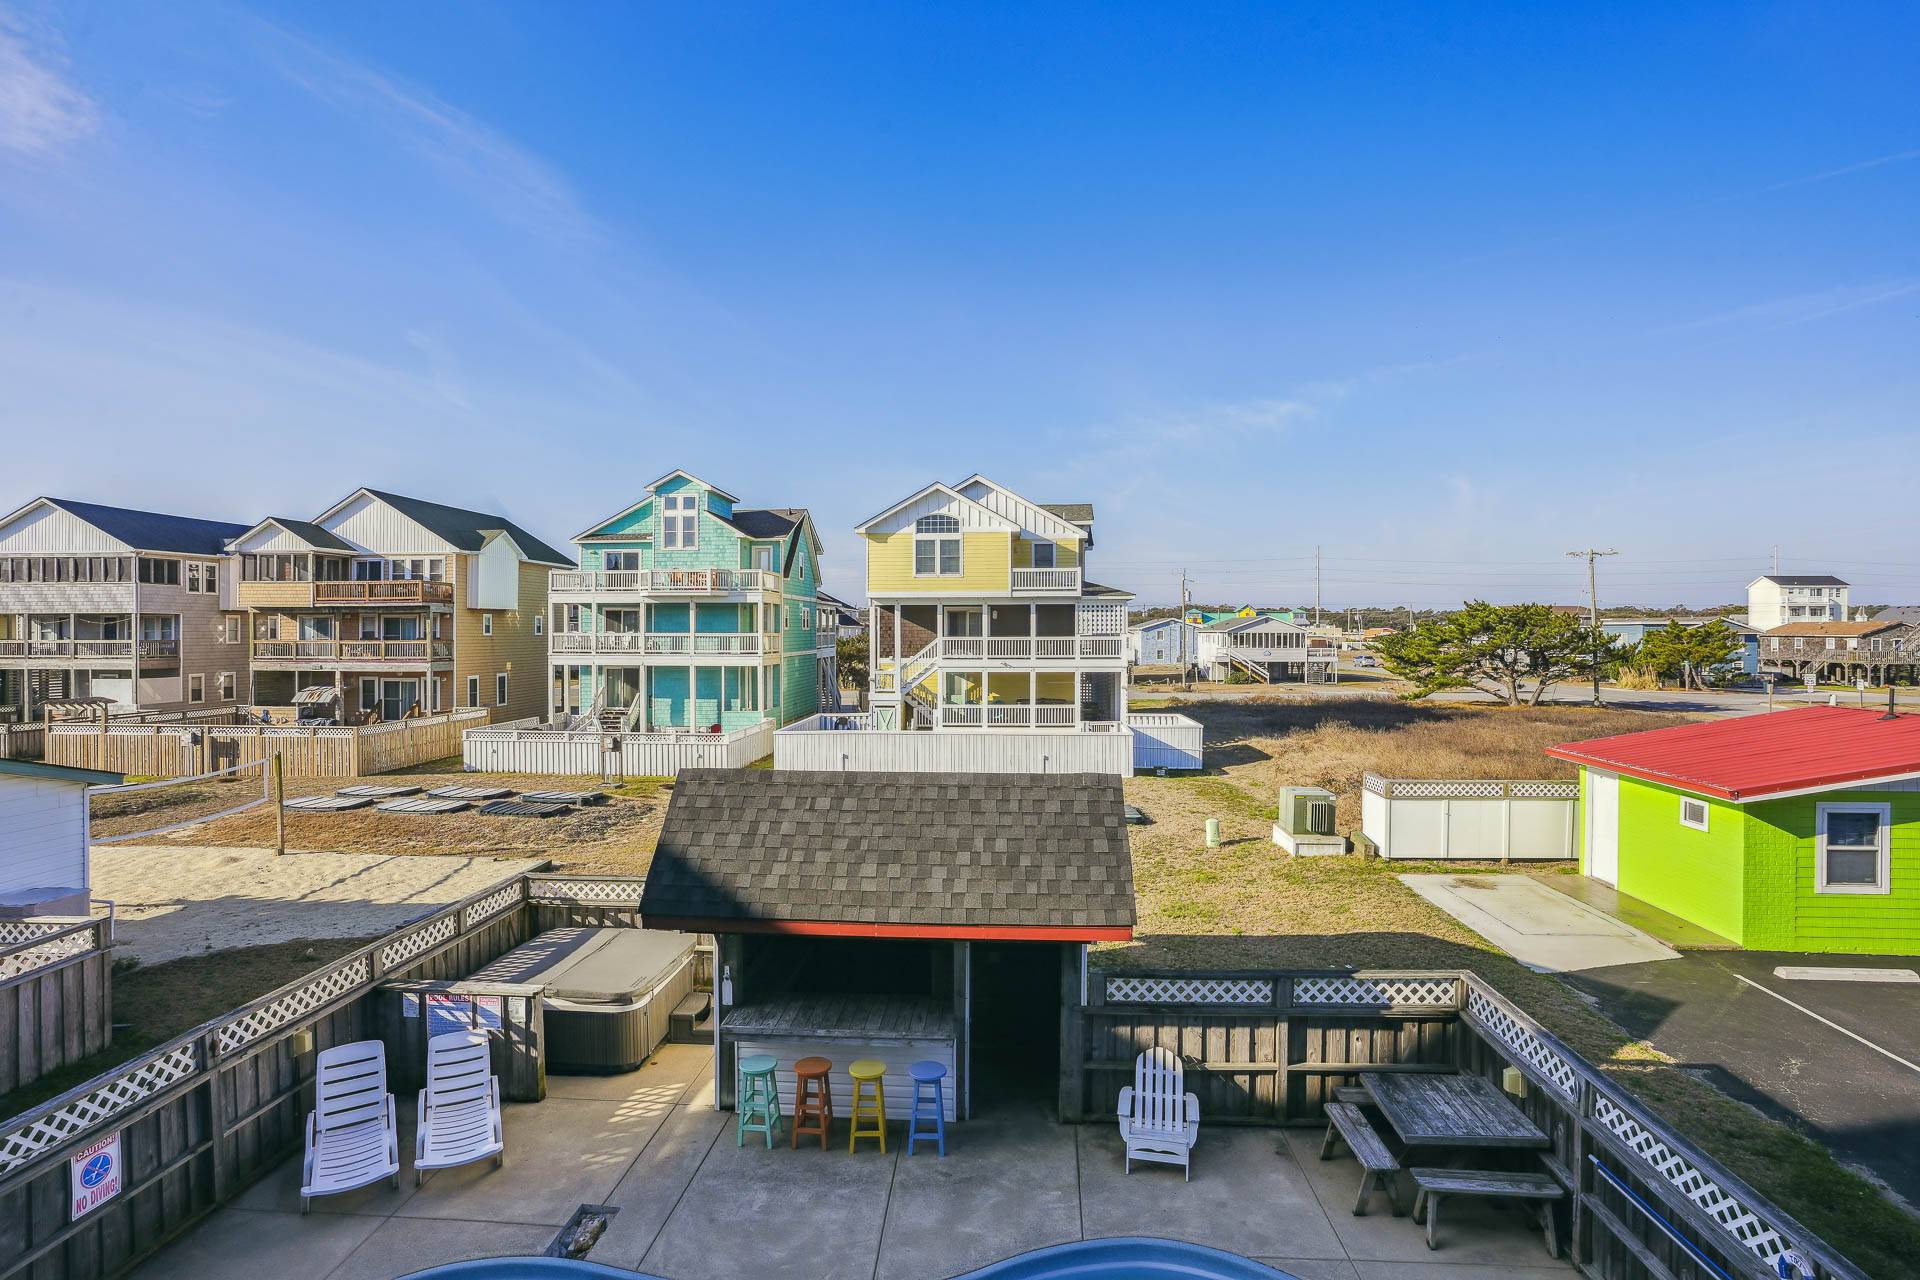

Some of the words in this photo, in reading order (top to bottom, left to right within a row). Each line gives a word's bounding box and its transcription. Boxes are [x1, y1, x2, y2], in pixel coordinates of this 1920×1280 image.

[77, 1135, 115, 1161] CAUTION!
[76, 1195, 88, 1214] NO
[90, 1176, 118, 1205] DIVING!
